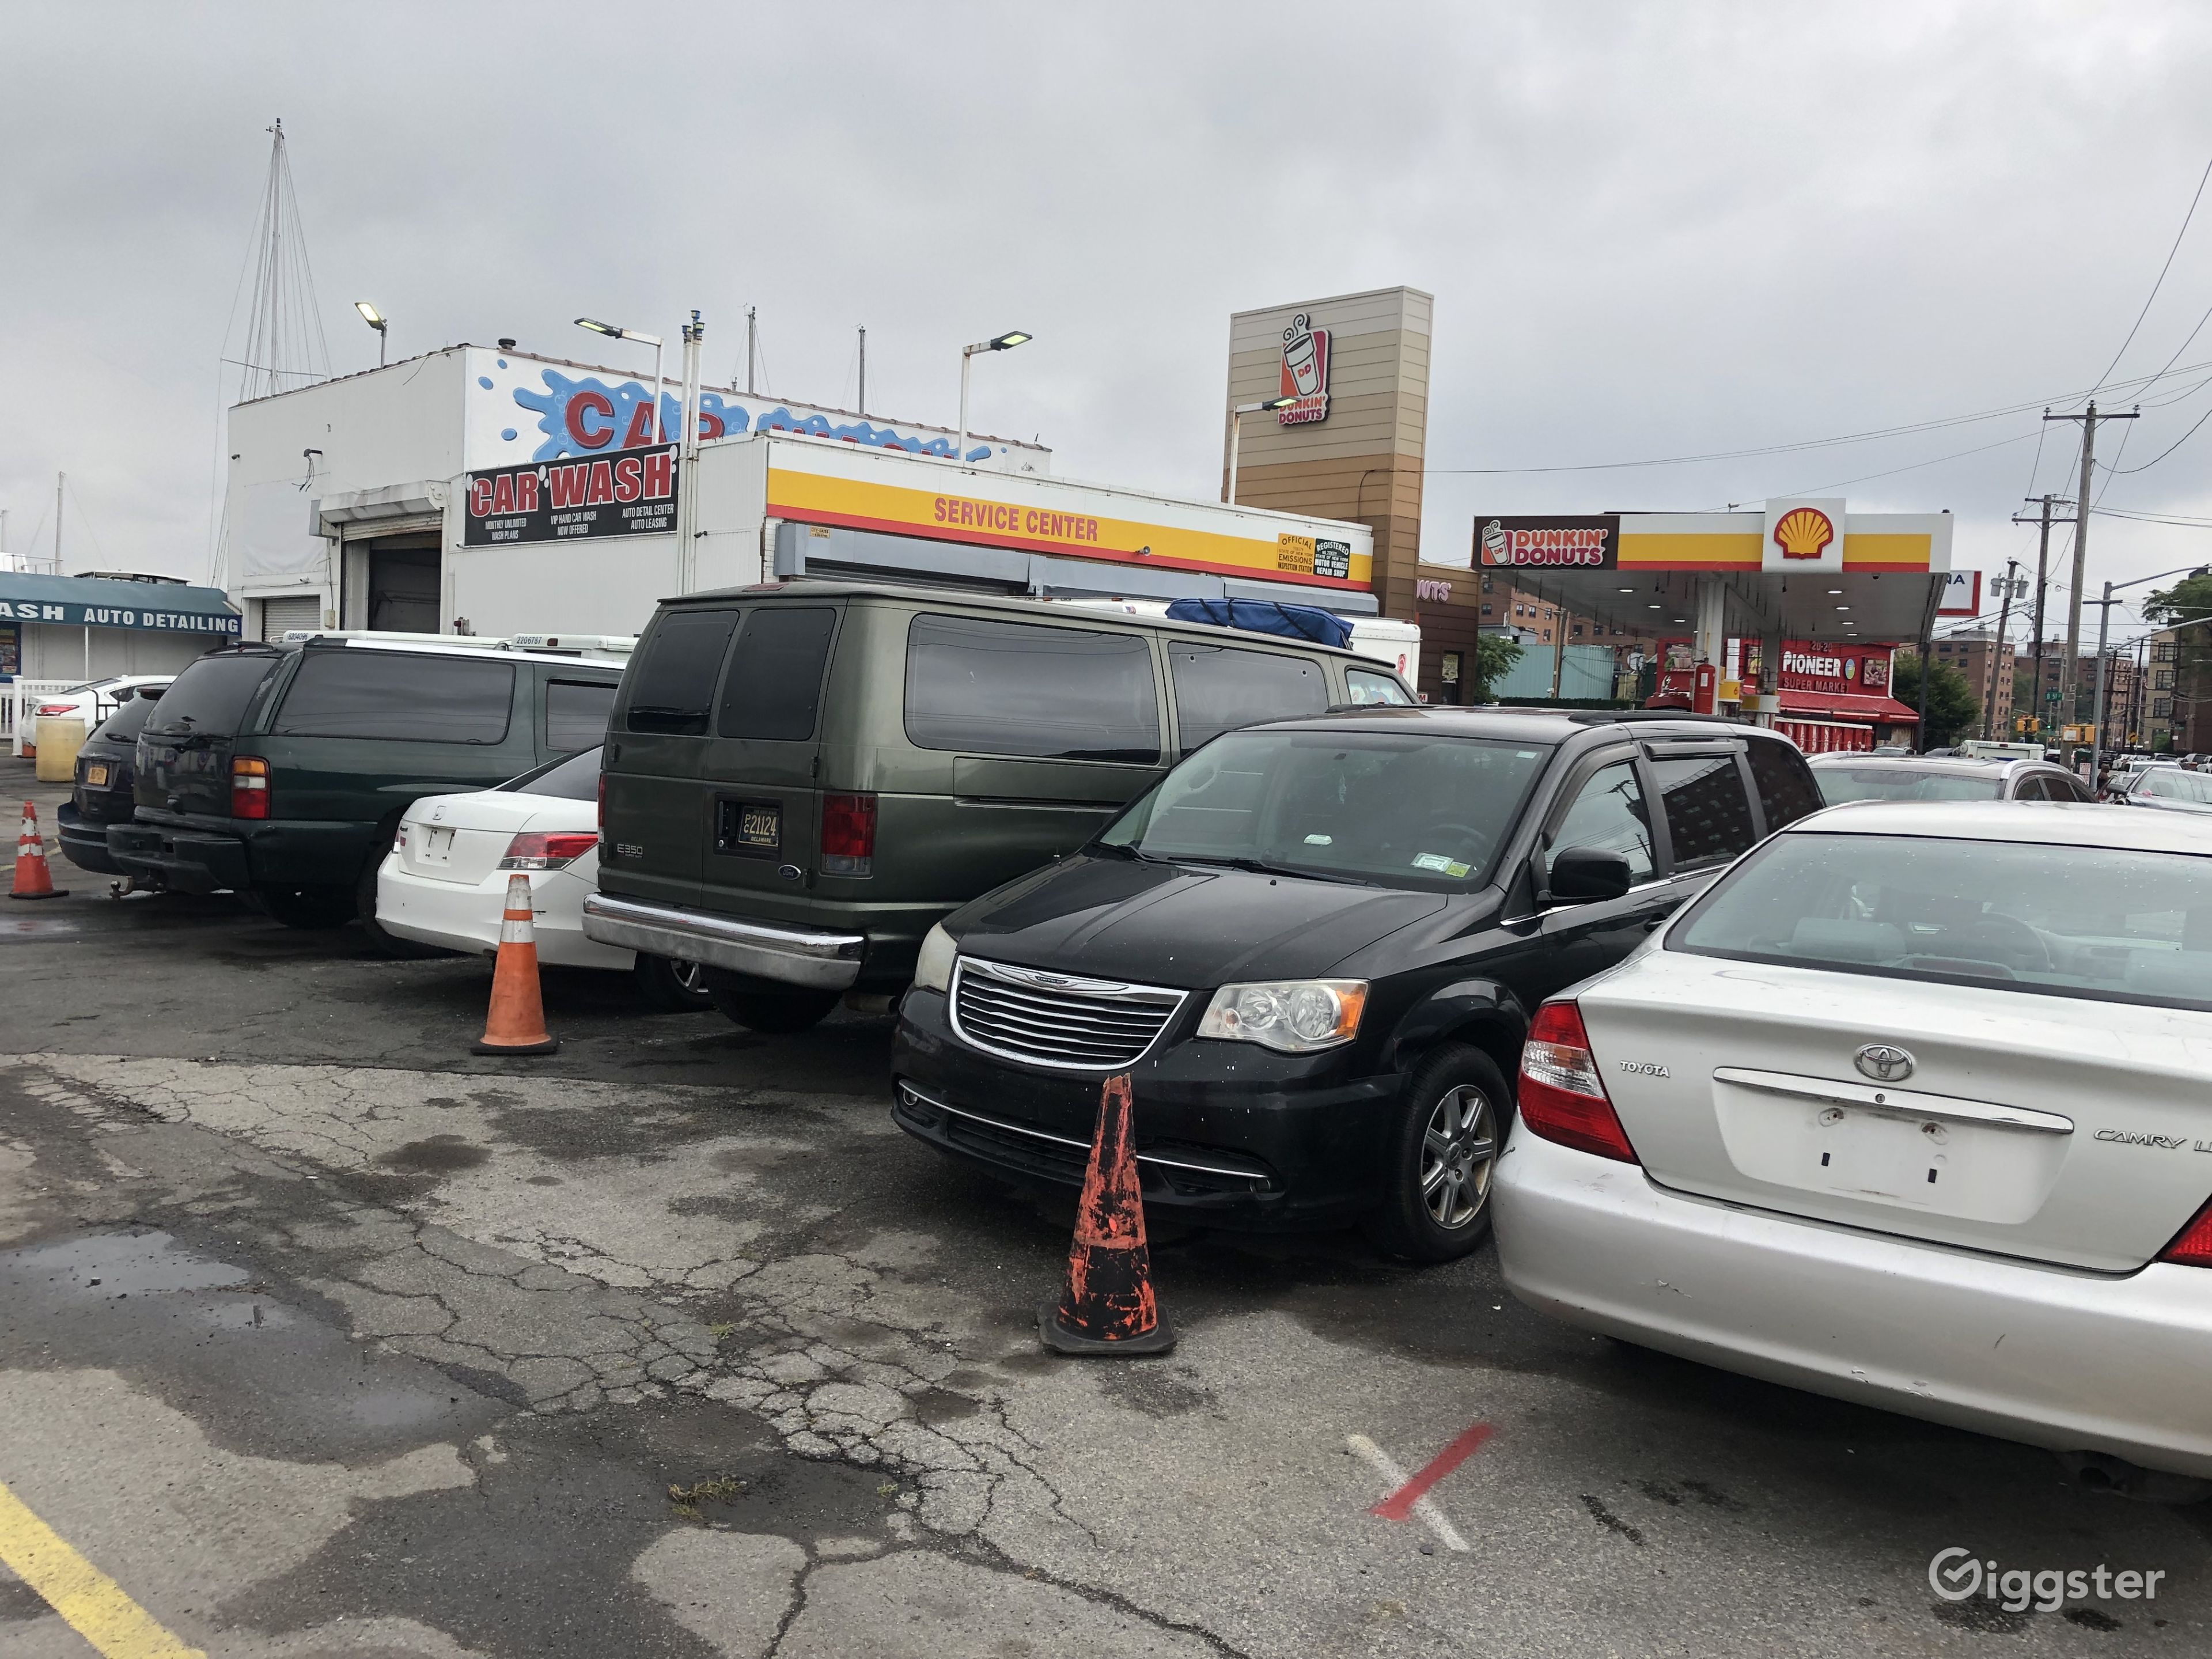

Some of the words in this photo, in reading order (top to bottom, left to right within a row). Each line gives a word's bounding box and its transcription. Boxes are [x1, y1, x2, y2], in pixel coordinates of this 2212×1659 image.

[1297, 363, 1311, 378] DD
[1279, 408, 1322, 424] DONUTS
[469, 471, 539, 517] CAR
[548, 452, 673, 509] WASH
[559, 514, 571, 524] HAND
[571, 513, 581, 522] CAR
[582, 511, 597, 521] WASH
[622, 507, 635, 518] AUTO
[636, 506, 653, 517] DETAIL
[654, 503, 674, 515] CENTER
[485, 520, 503, 530] MONTHLY
[505, 518, 527, 528] UNLIMITED
[631, 518, 645, 529] AUTO
[646, 517, 667, 528] LEASING
[934, 497, 1019, 531] SERVICE
[1026, 510, 1097, 541] CENTER
[492, 531, 503, 540] WASH
[504, 529, 518, 539] PLANS
[557, 525, 568, 536] NOW
[569, 524, 588, 535] OFFERED
[1282, 536, 1312, 550] OFFICIAL
[1516, 530, 1607, 547] DUNKIN'
[1316, 541, 1349, 555] REGISTERED
[1278, 554, 1312, 565] EMISSIONS
[1514, 547, 1601, 564] DONUTS
[1278, 562, 1297, 571] INSPECTION
[1298, 565, 1312, 573] STATION
[1315, 558, 1330, 567] MOTOR
[1331, 560, 1348, 570] VEHICLE
[1316, 566, 1332, 575] REPAIR
[1333, 569, 1345, 577] SHOP
[84, 608, 134, 625] AUTO
[143, 612, 238, 632] DETAILING
[517, 636, 542, 644] 2206787
[1812, 641, 1832, 653] 20-20
[1782, 651, 1840, 677] PIONEER
[1783, 677, 1812, 690] SUPER
[1815, 680, 1849, 694] MARKET
[749, 815, 777, 836] 21124
[618, 843, 643, 855] E350
[1620, 1060, 1670, 1078] TOYOTA
[2094, 1129, 2187, 1149] CAMRY
[2194, 1140, 2212, 1153] L
